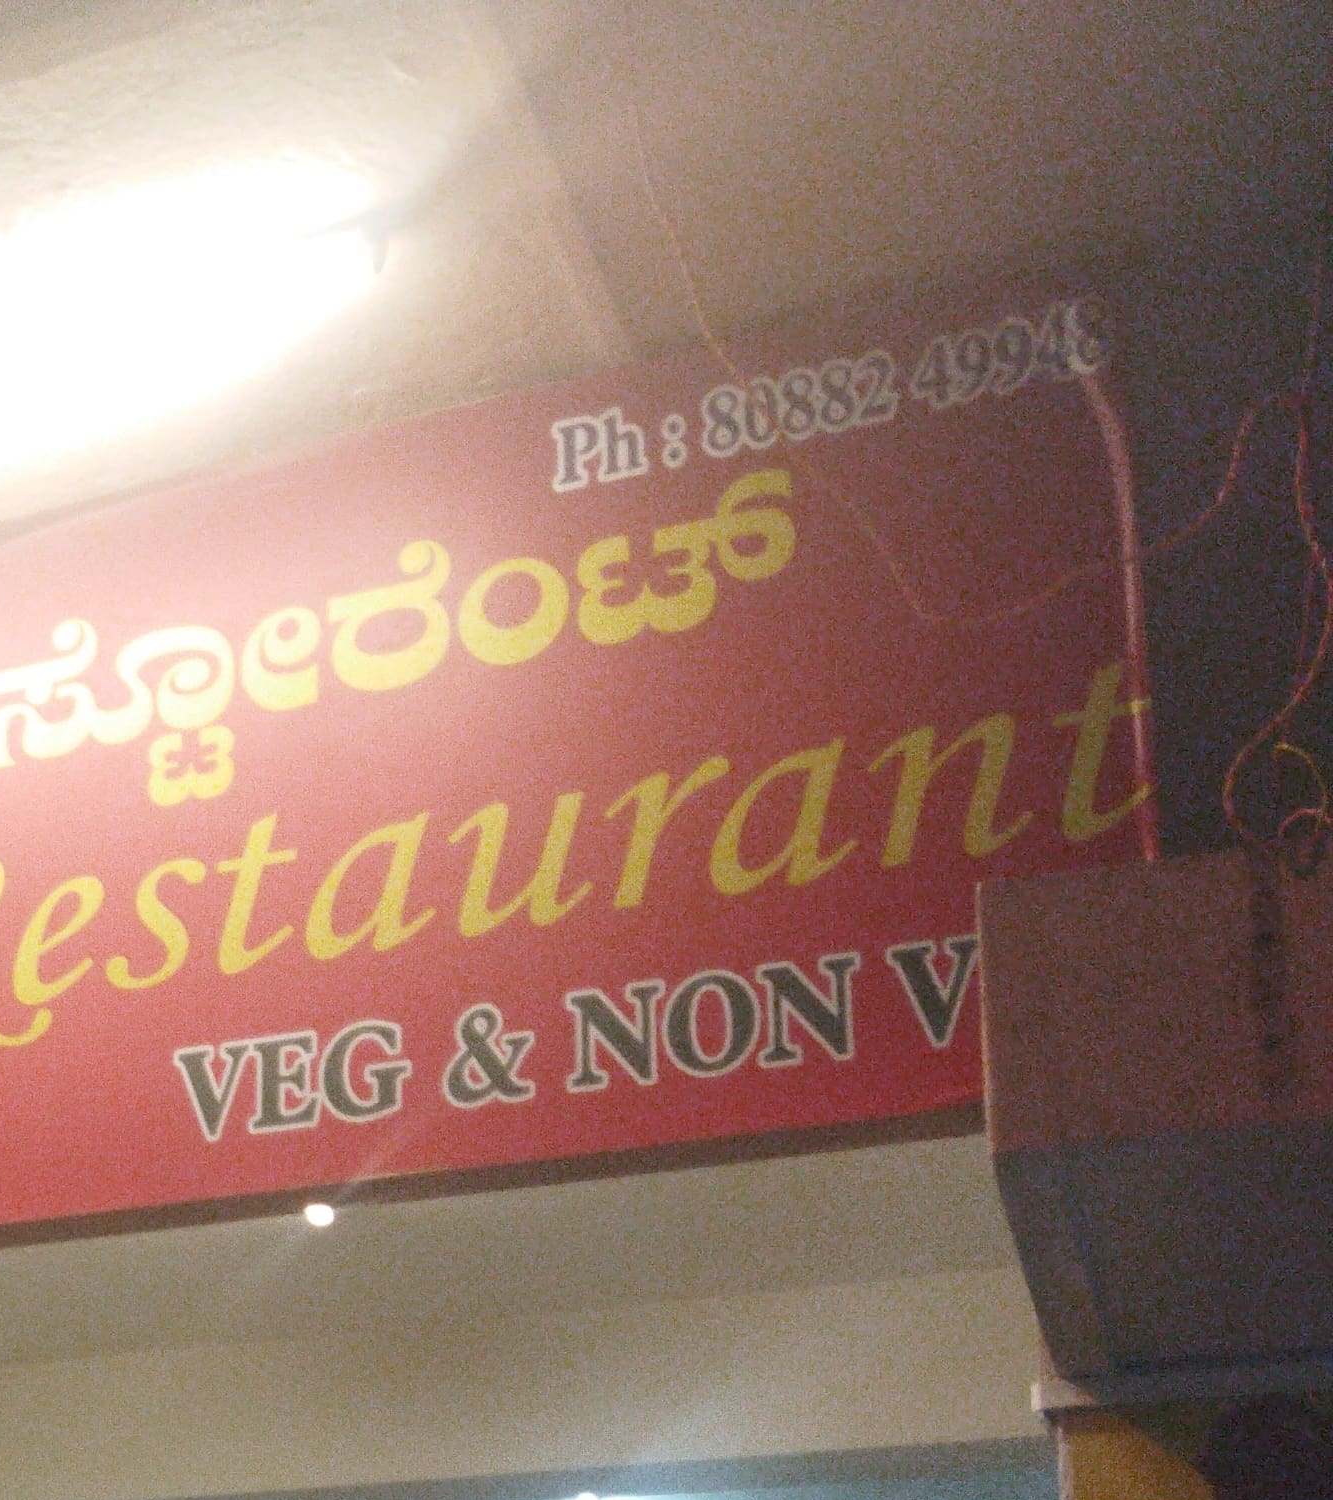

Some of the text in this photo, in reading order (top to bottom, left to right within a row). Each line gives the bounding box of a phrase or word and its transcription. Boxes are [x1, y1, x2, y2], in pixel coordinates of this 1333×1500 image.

[550, 407, 648, 492] Ph
[702, 350, 900, 458] 80882
[174, 1020, 412, 1143] VEG
[443, 1003, 535, 1109] &
[568, 952, 860, 1093] NON
